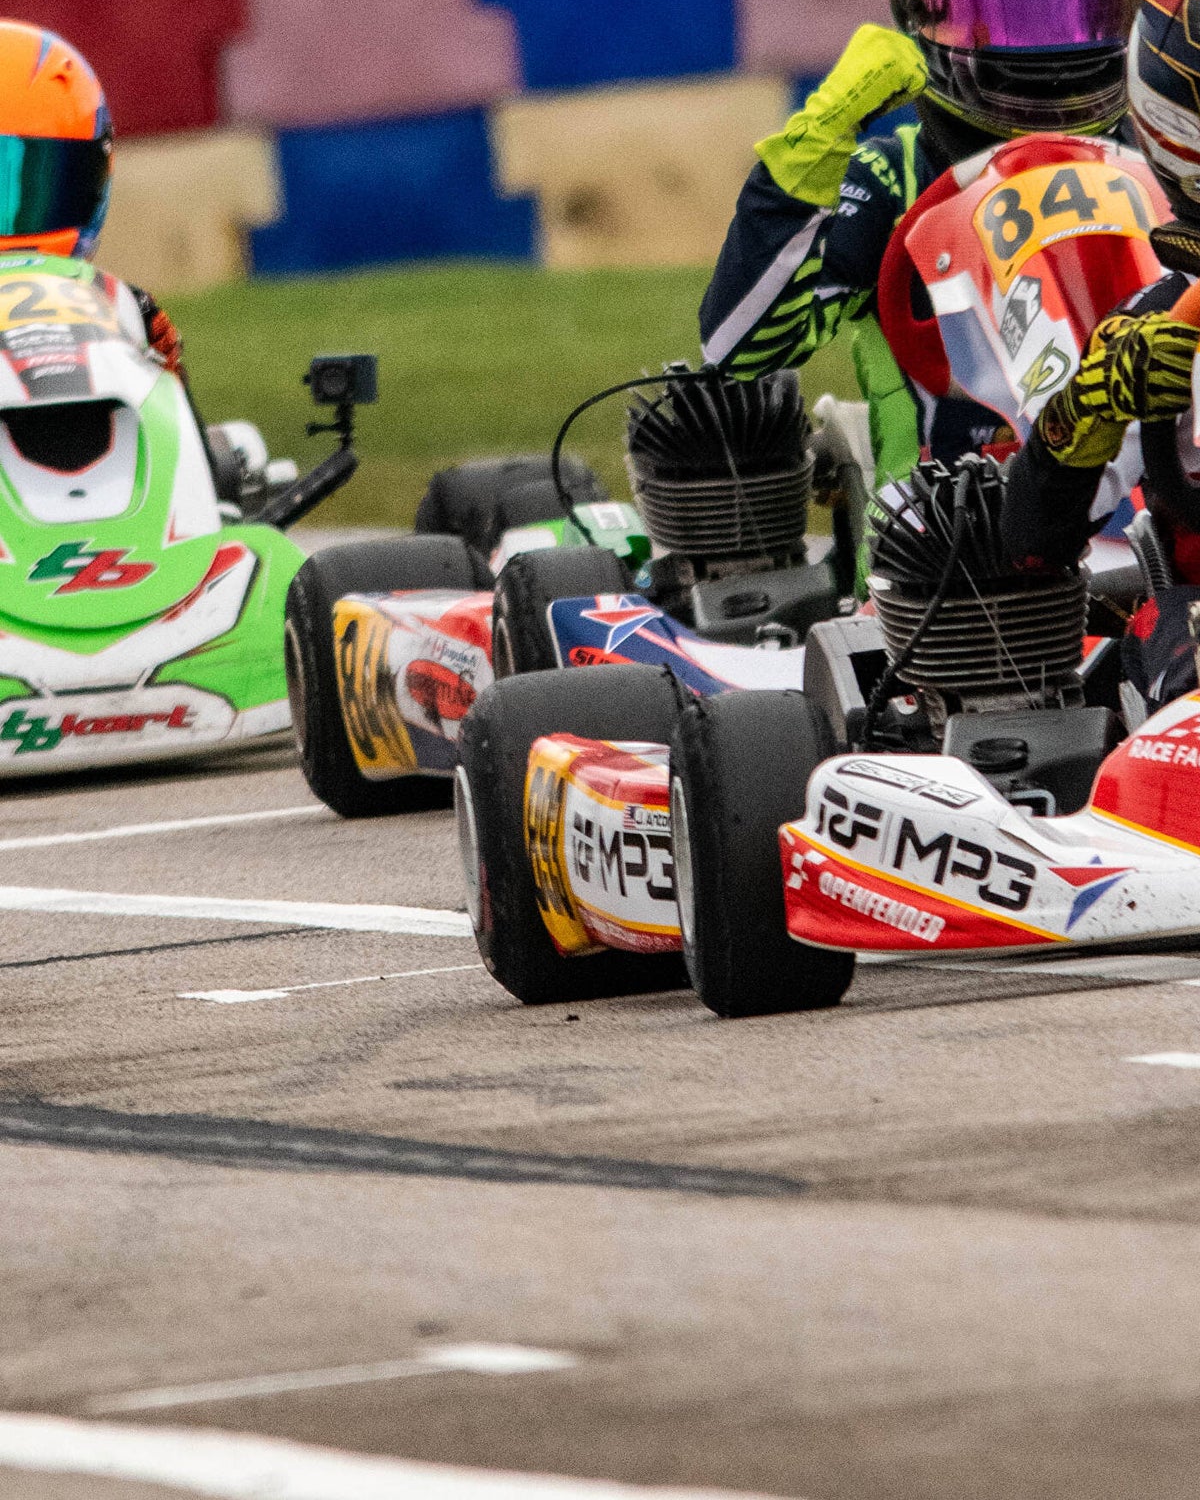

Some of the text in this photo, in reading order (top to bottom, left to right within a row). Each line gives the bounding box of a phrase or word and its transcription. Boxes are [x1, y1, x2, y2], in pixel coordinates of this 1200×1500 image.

[983, 168, 1152, 261] 841
[1128, 738, 1176, 764] RACE
[892, 816, 1038, 913] MPG
[817, 871, 947, 943] OPENFENDER
